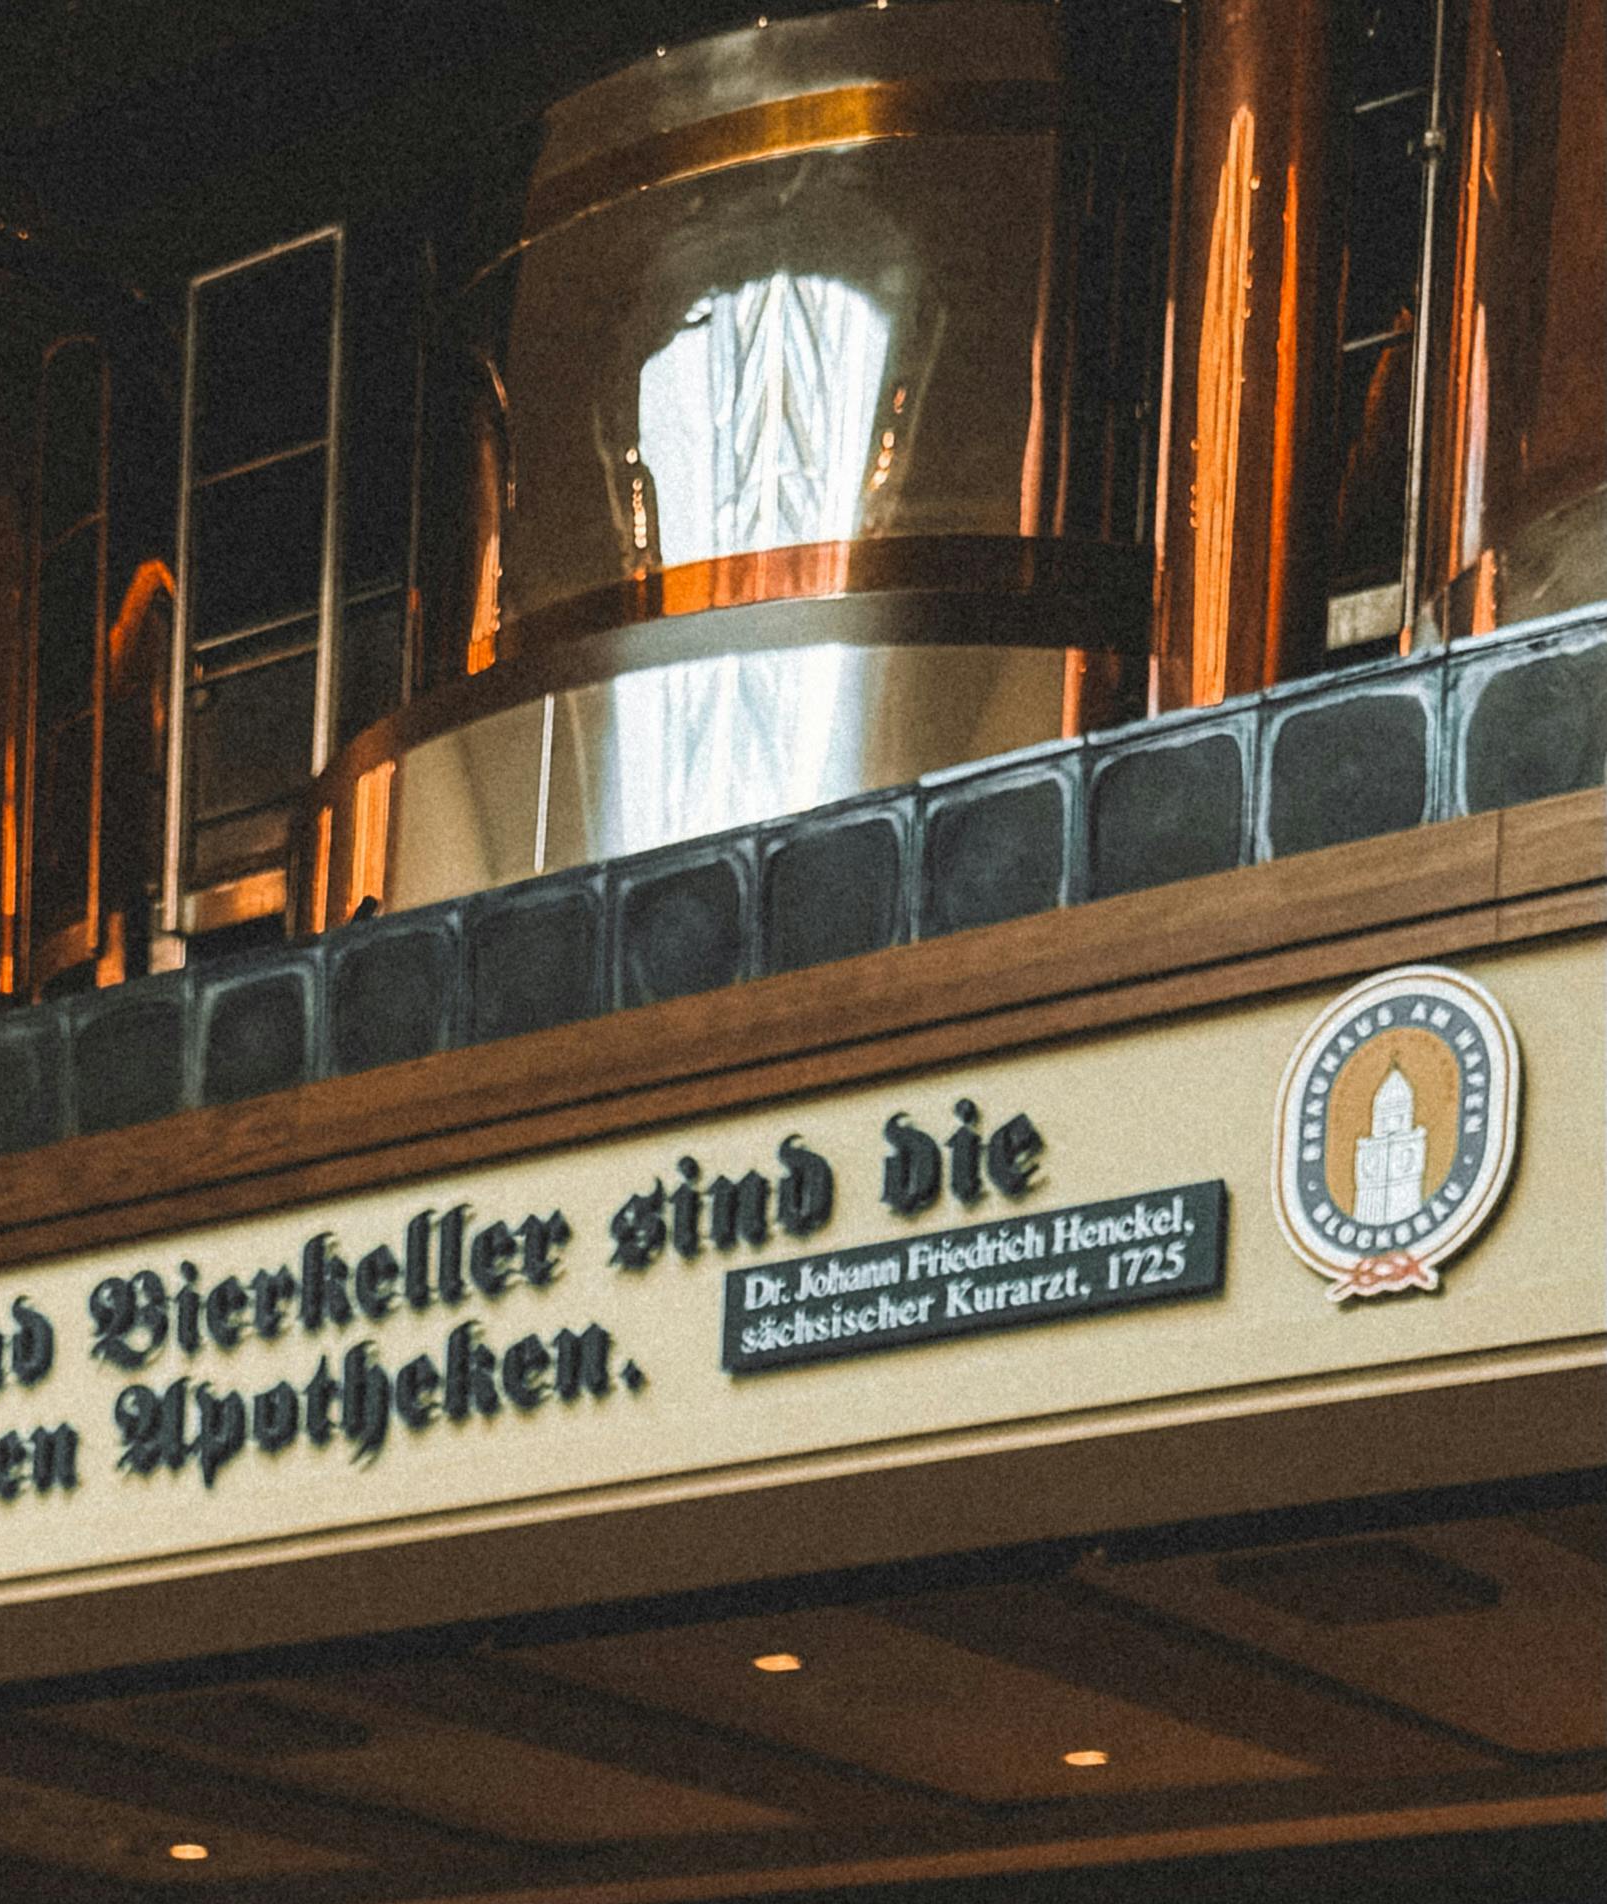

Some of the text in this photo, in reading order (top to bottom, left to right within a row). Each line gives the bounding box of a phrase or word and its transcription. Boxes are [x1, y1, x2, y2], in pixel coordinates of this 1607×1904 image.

[1409, 1001, 1452, 1031] AM
[89, 1203, 572, 1371] Bierkeller
[608, 1134, 836, 1273] sind
[882, 1097, 1046, 1218] die
[742, 1273, 791, 1312] Dr.
[794, 1254, 902, 1303] Johann
[906, 1225, 1046, 1282] Friedrich
[739, 1240, 1189, 1355] sächsischer Kurarzt, 1725
[113, 1320, 648, 1489] Apotheken.
